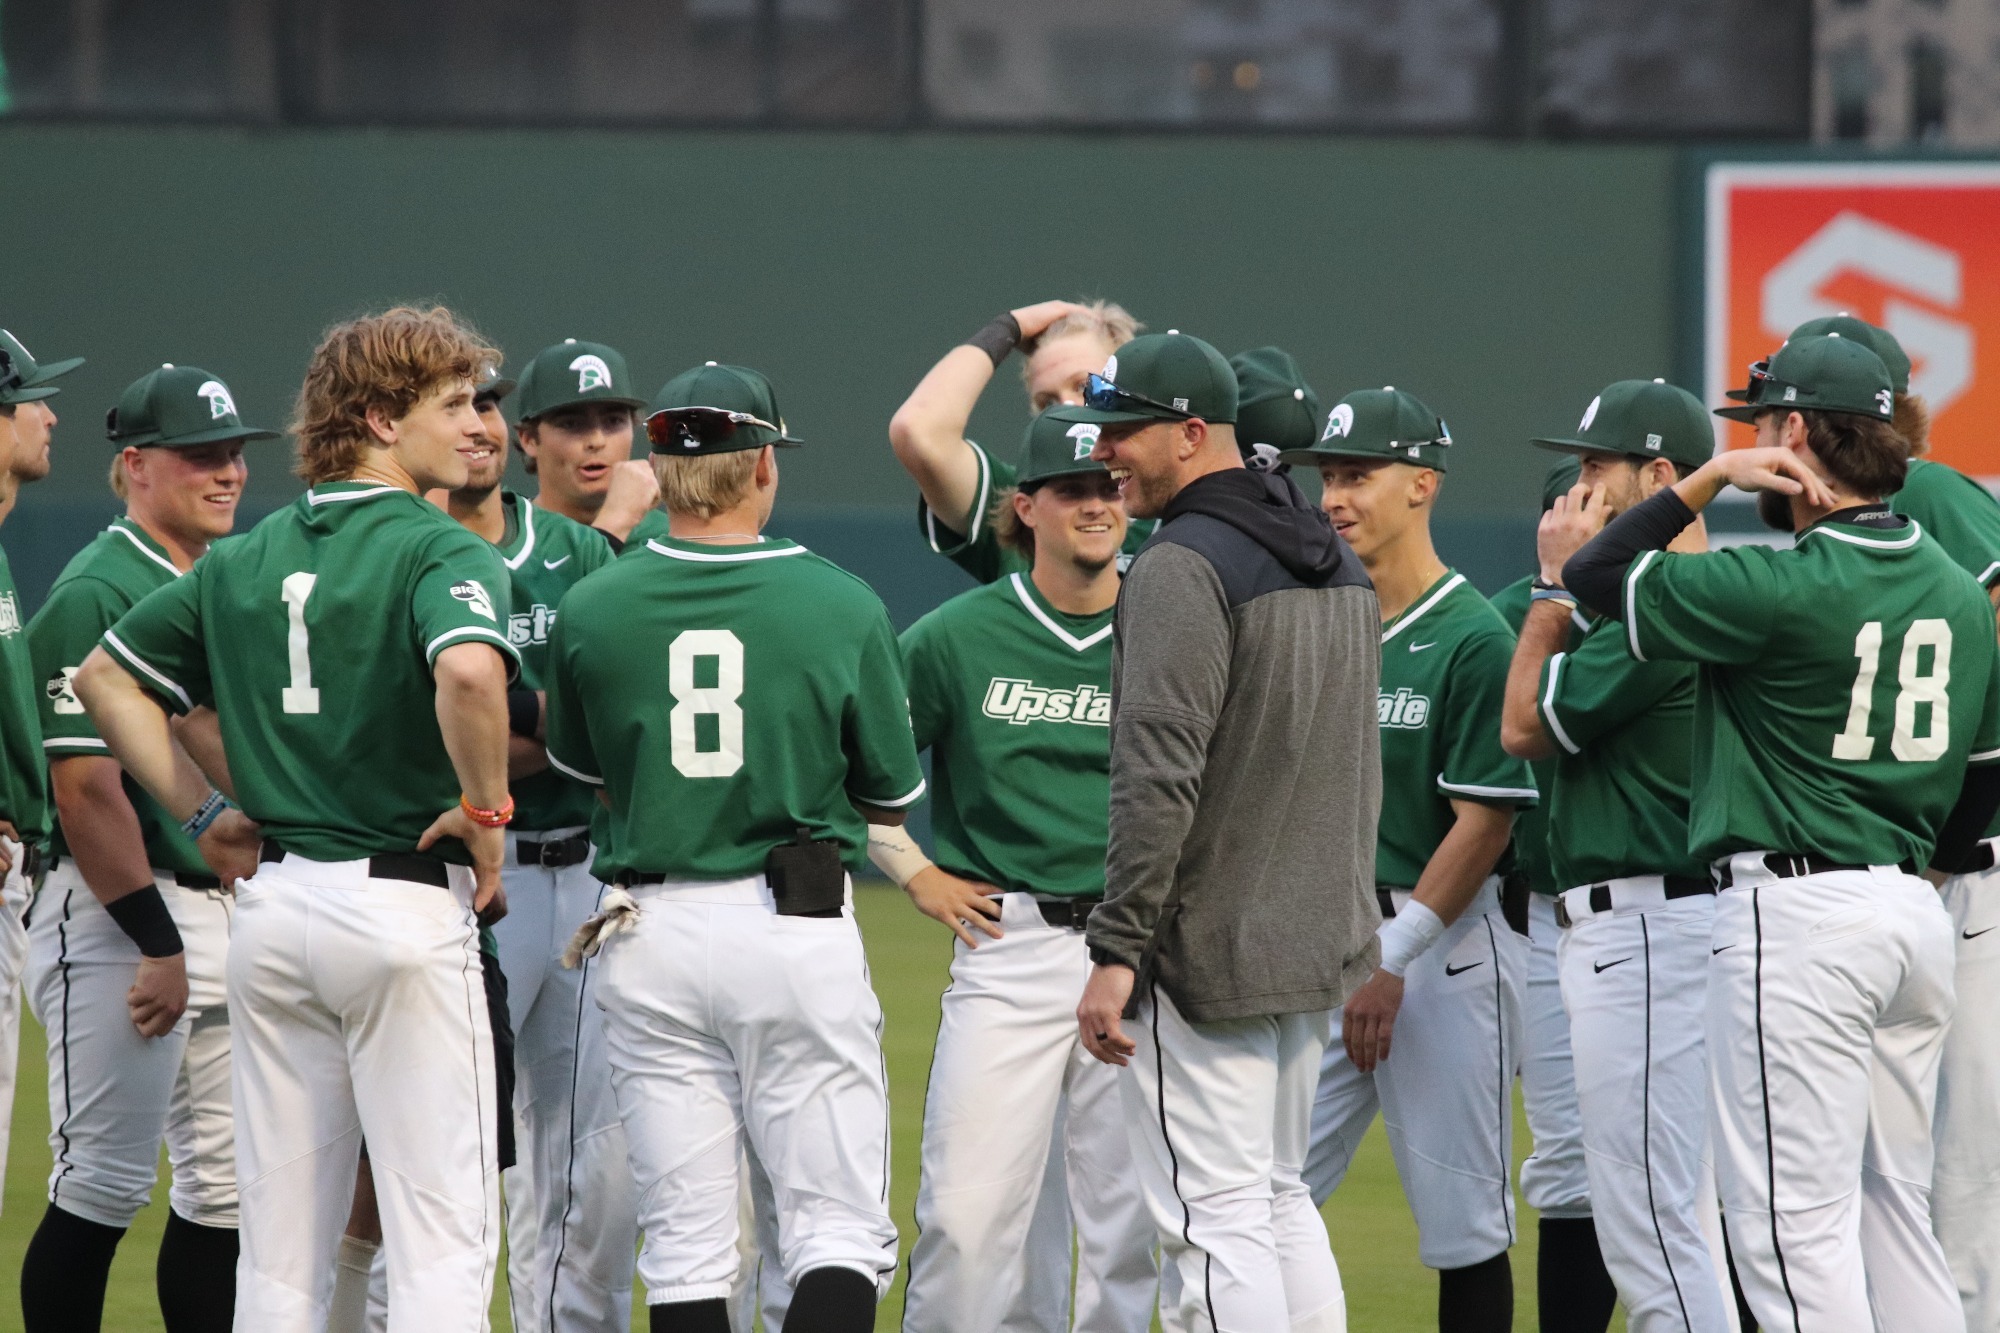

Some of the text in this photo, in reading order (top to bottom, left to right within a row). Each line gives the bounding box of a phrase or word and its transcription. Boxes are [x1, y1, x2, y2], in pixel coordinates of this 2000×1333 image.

[281, 571, 320, 714] 1
[450, 585, 476, 595] BIG
[47, 676, 67, 690] BIG
[668, 629, 744, 778] 8
[1831, 618, 1953, 762] 18
